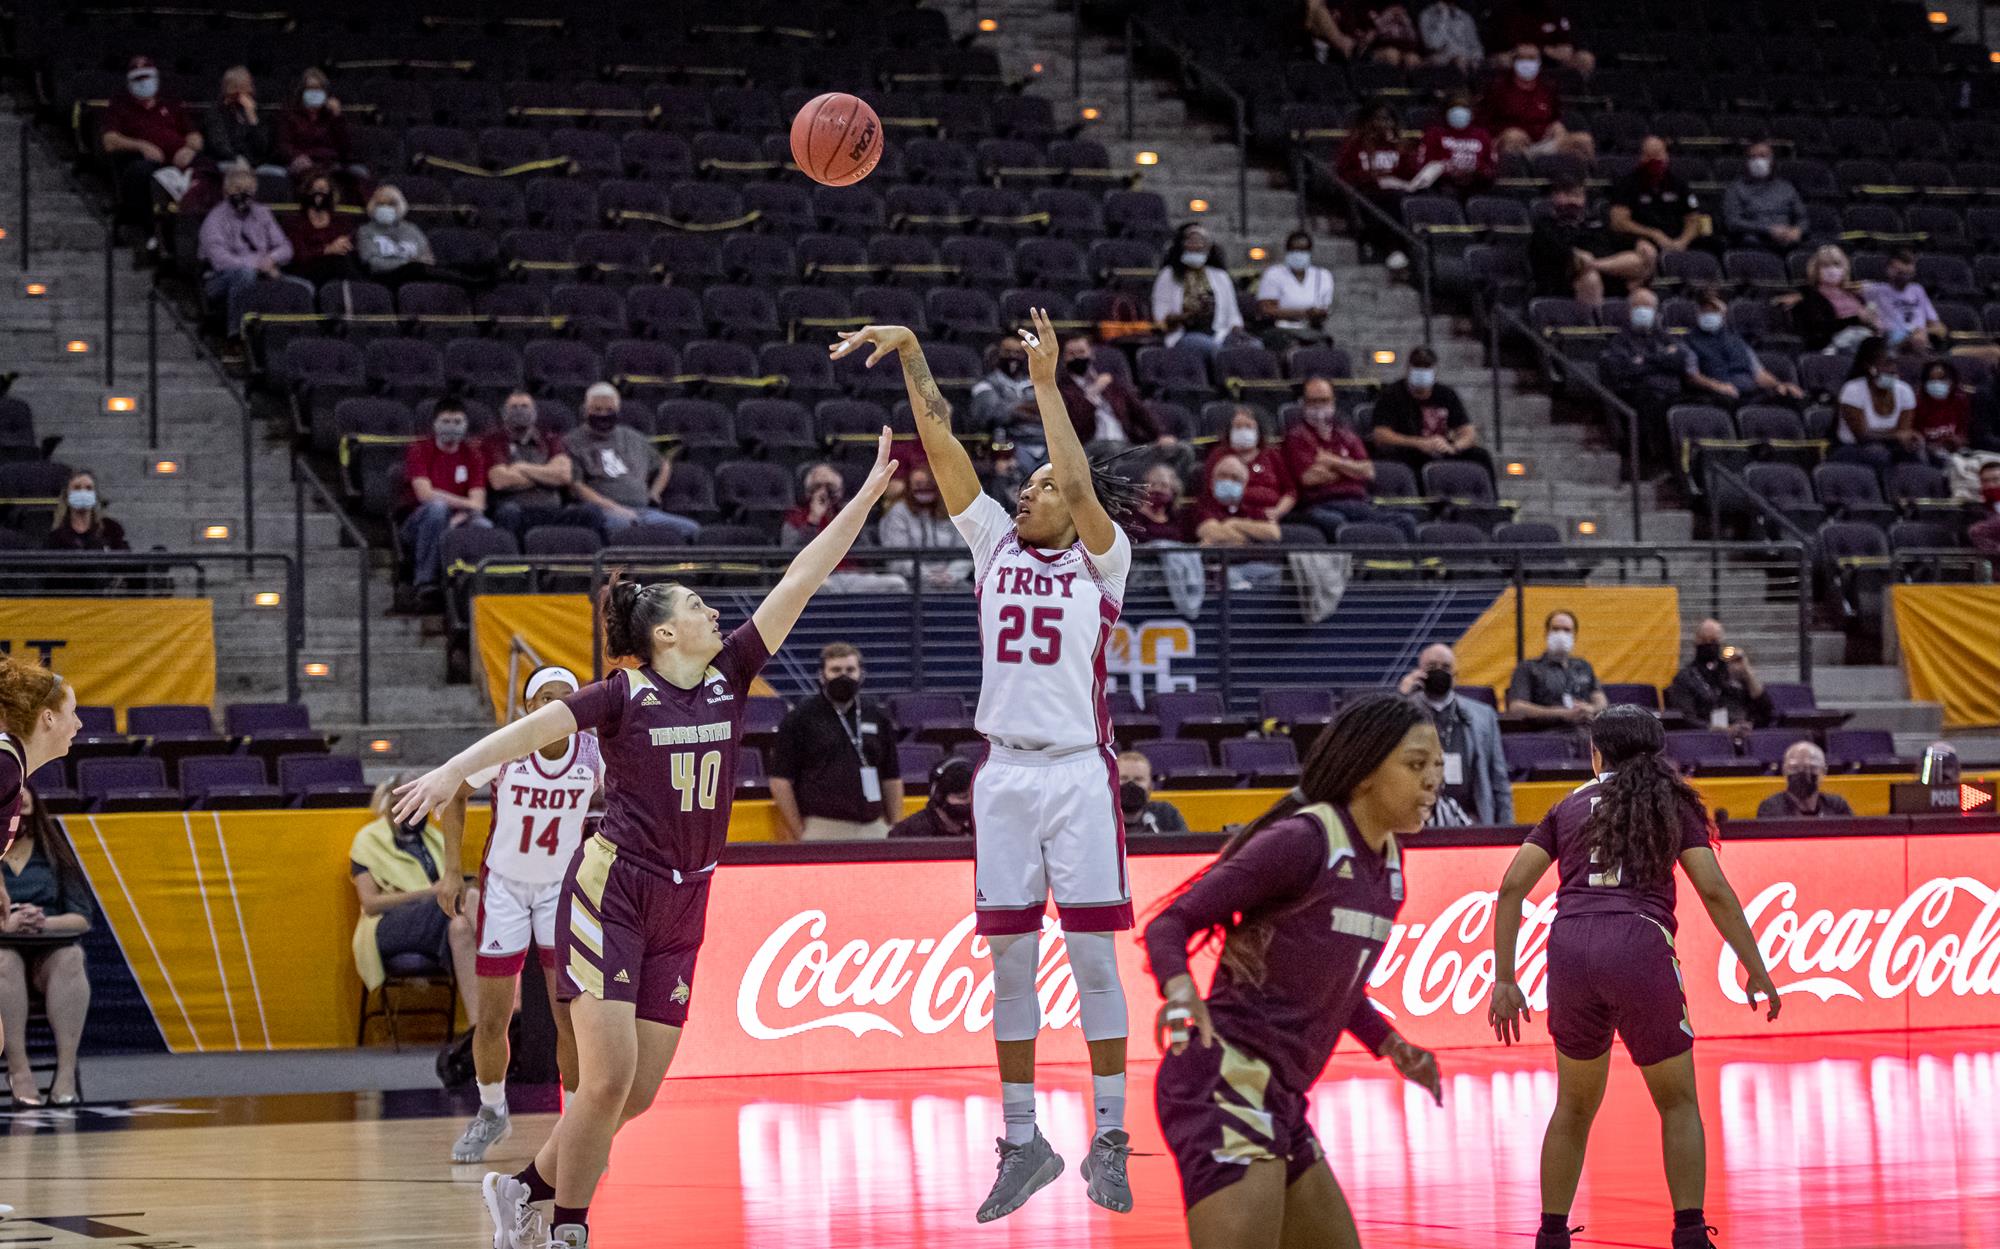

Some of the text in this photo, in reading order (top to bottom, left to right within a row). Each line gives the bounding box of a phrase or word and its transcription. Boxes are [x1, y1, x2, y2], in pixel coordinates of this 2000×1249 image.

[849, 117, 876, 161] NCAA
[996, 566, 1077, 599] TROY
[996, 604, 1064, 666] 25
[648, 726, 699, 747] TEXAS
[510, 784, 585, 810] TROY
[670, 750, 722, 812] 40
[519, 815, 562, 856] 14
